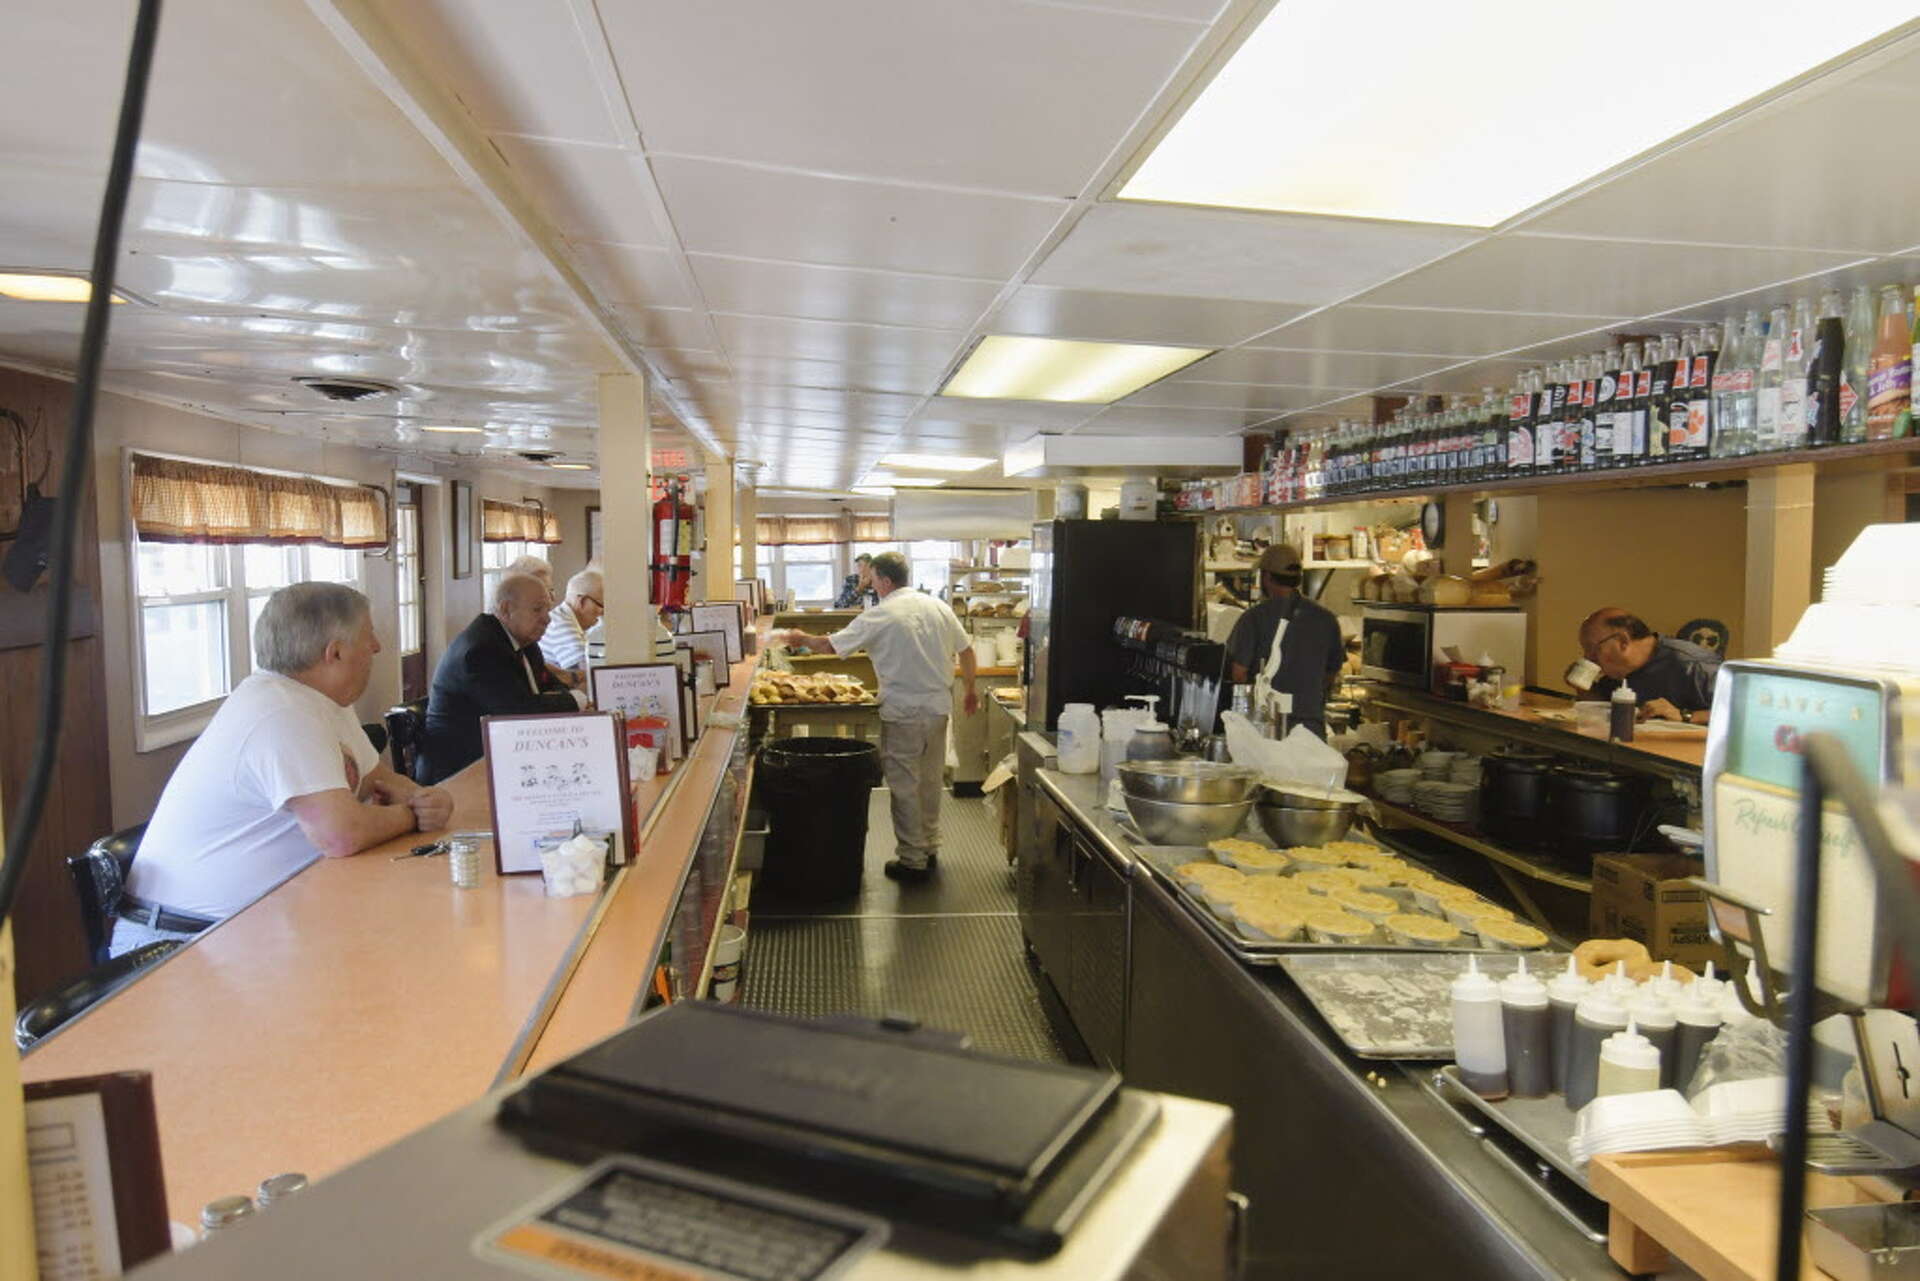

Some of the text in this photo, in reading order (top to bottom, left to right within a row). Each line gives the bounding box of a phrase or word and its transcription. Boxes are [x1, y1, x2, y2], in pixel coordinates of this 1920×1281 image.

[517, 725, 584, 737] WELCOME TO
[513, 736, 589, 753] DUNCAN'S
